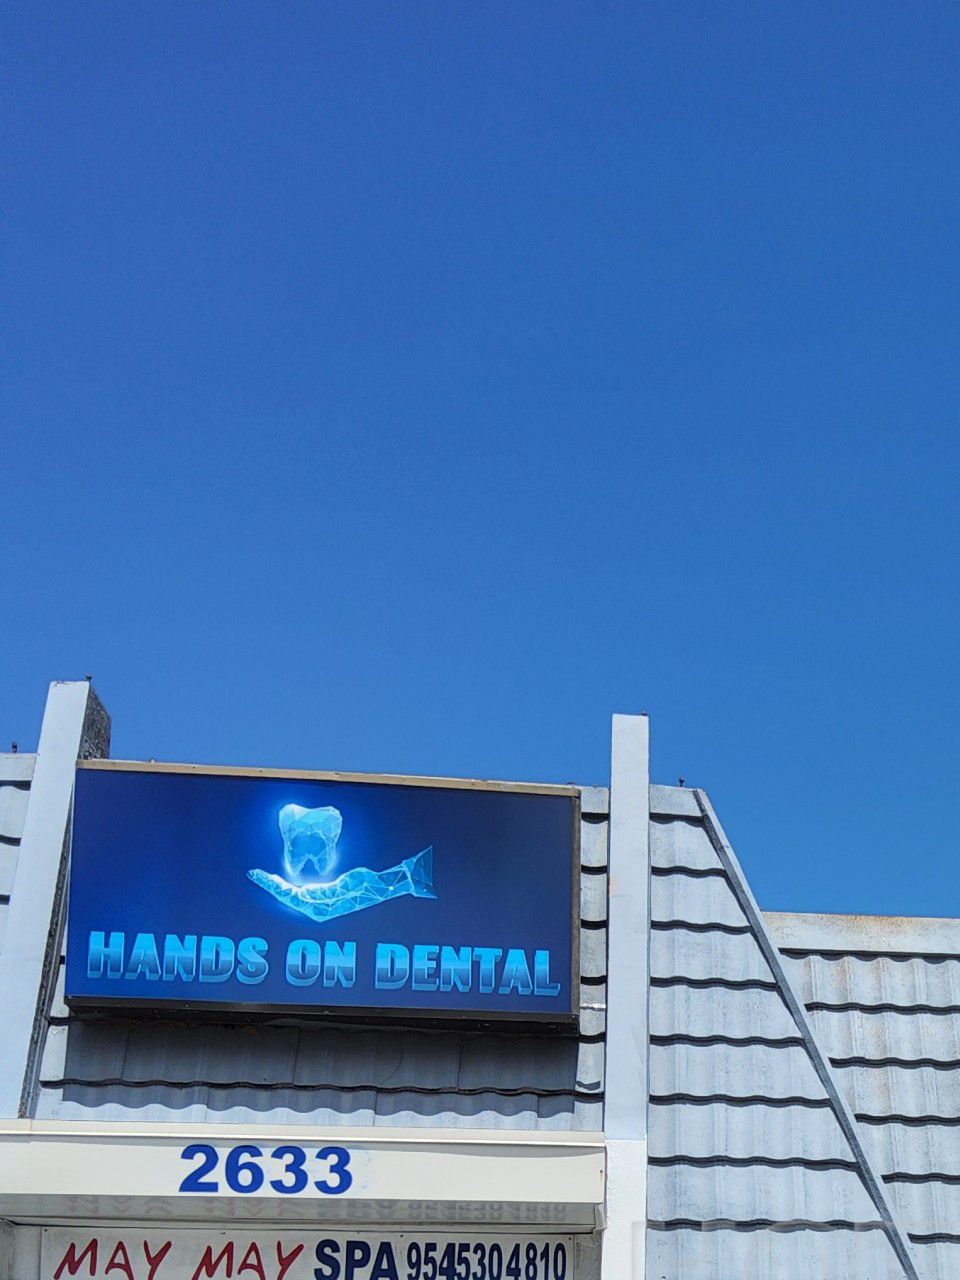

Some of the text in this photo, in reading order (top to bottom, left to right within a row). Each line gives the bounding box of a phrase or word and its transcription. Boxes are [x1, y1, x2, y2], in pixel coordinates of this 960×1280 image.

[87, 931, 561, 996] HANDS ON DENTAL
[178, 1144, 353, 1194] 2633
